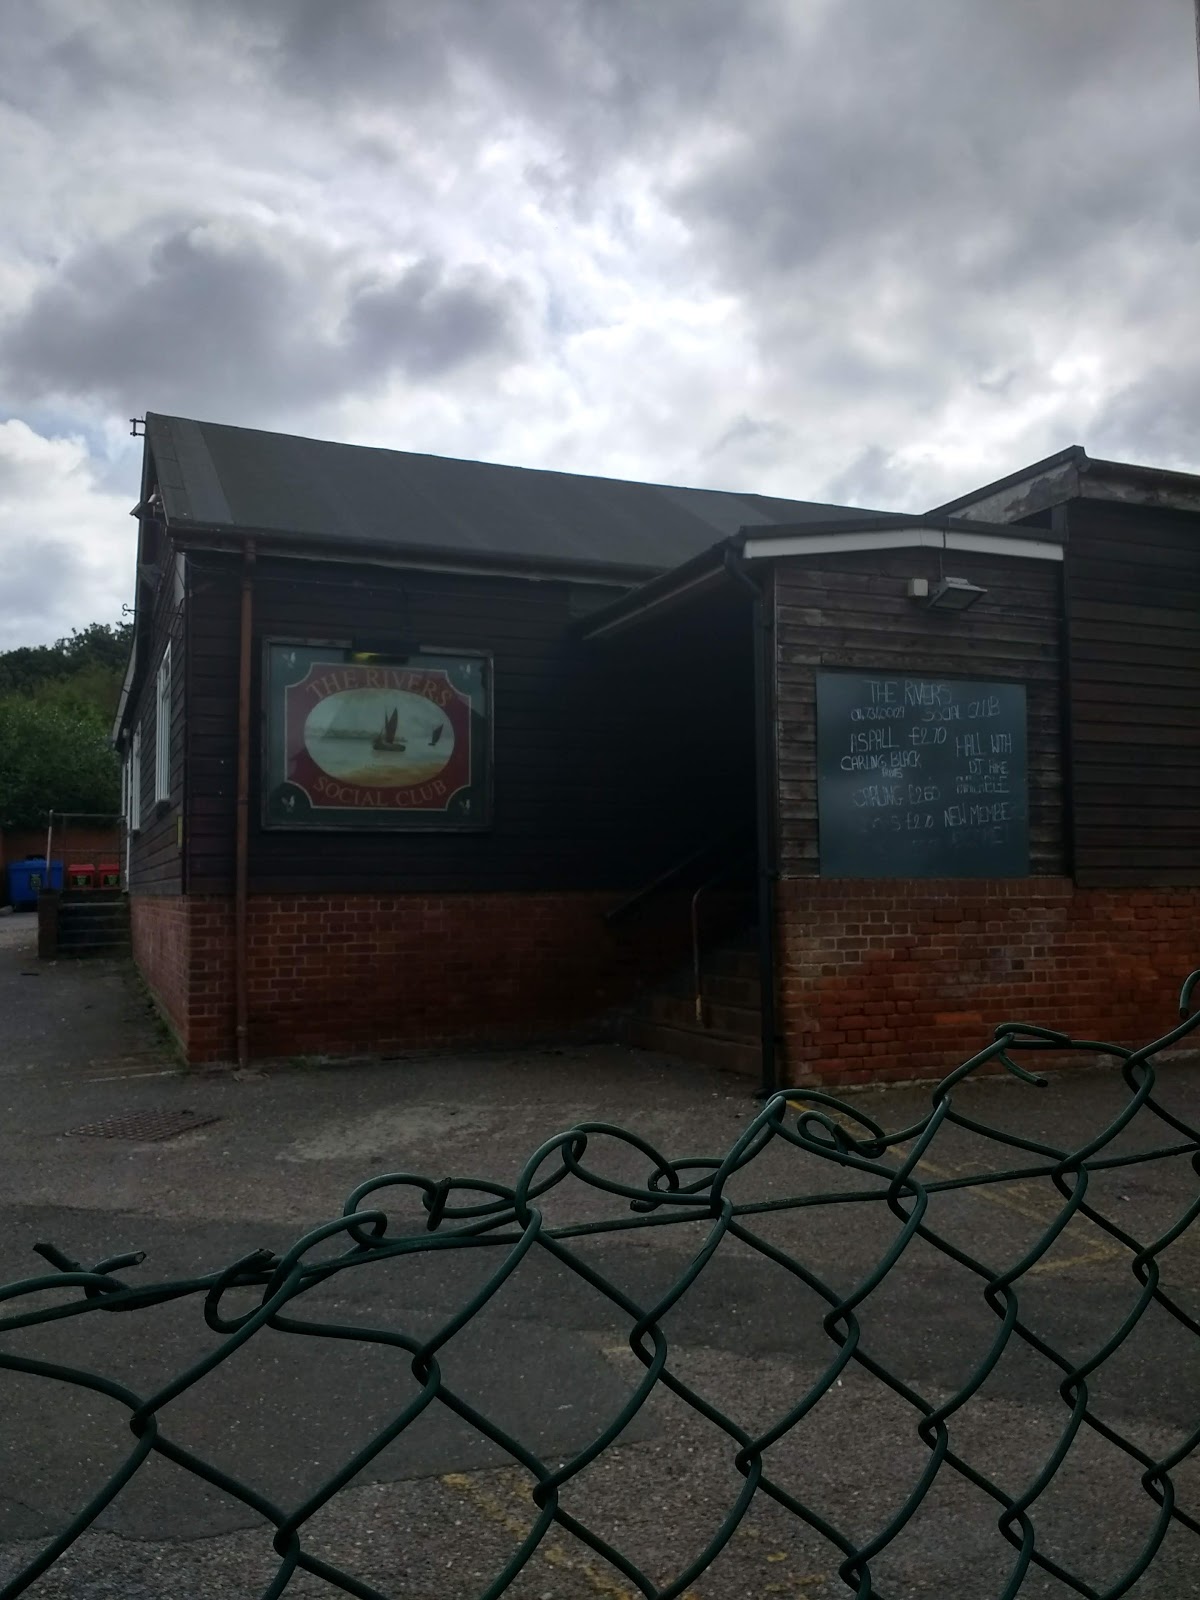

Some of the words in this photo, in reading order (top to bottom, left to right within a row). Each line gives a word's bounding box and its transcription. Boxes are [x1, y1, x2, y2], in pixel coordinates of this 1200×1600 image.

[306, 668, 360, 700] THE
[366, 669, 454, 707] RIVERS
[863, 680, 899, 703] THE
[968, 696, 1001, 719] CLUB
[850, 726, 900, 753] ASPALL
[956, 731, 986, 757] HALL
[890, 750, 922, 768] BLACK
[968, 758, 985, 775] DJ
[313, 776, 389, 806] SOCIAL
[395, 779, 448, 807] CLUB
[944, 802, 967, 827] NEW
[970, 801, 1020, 825] MEMBE
